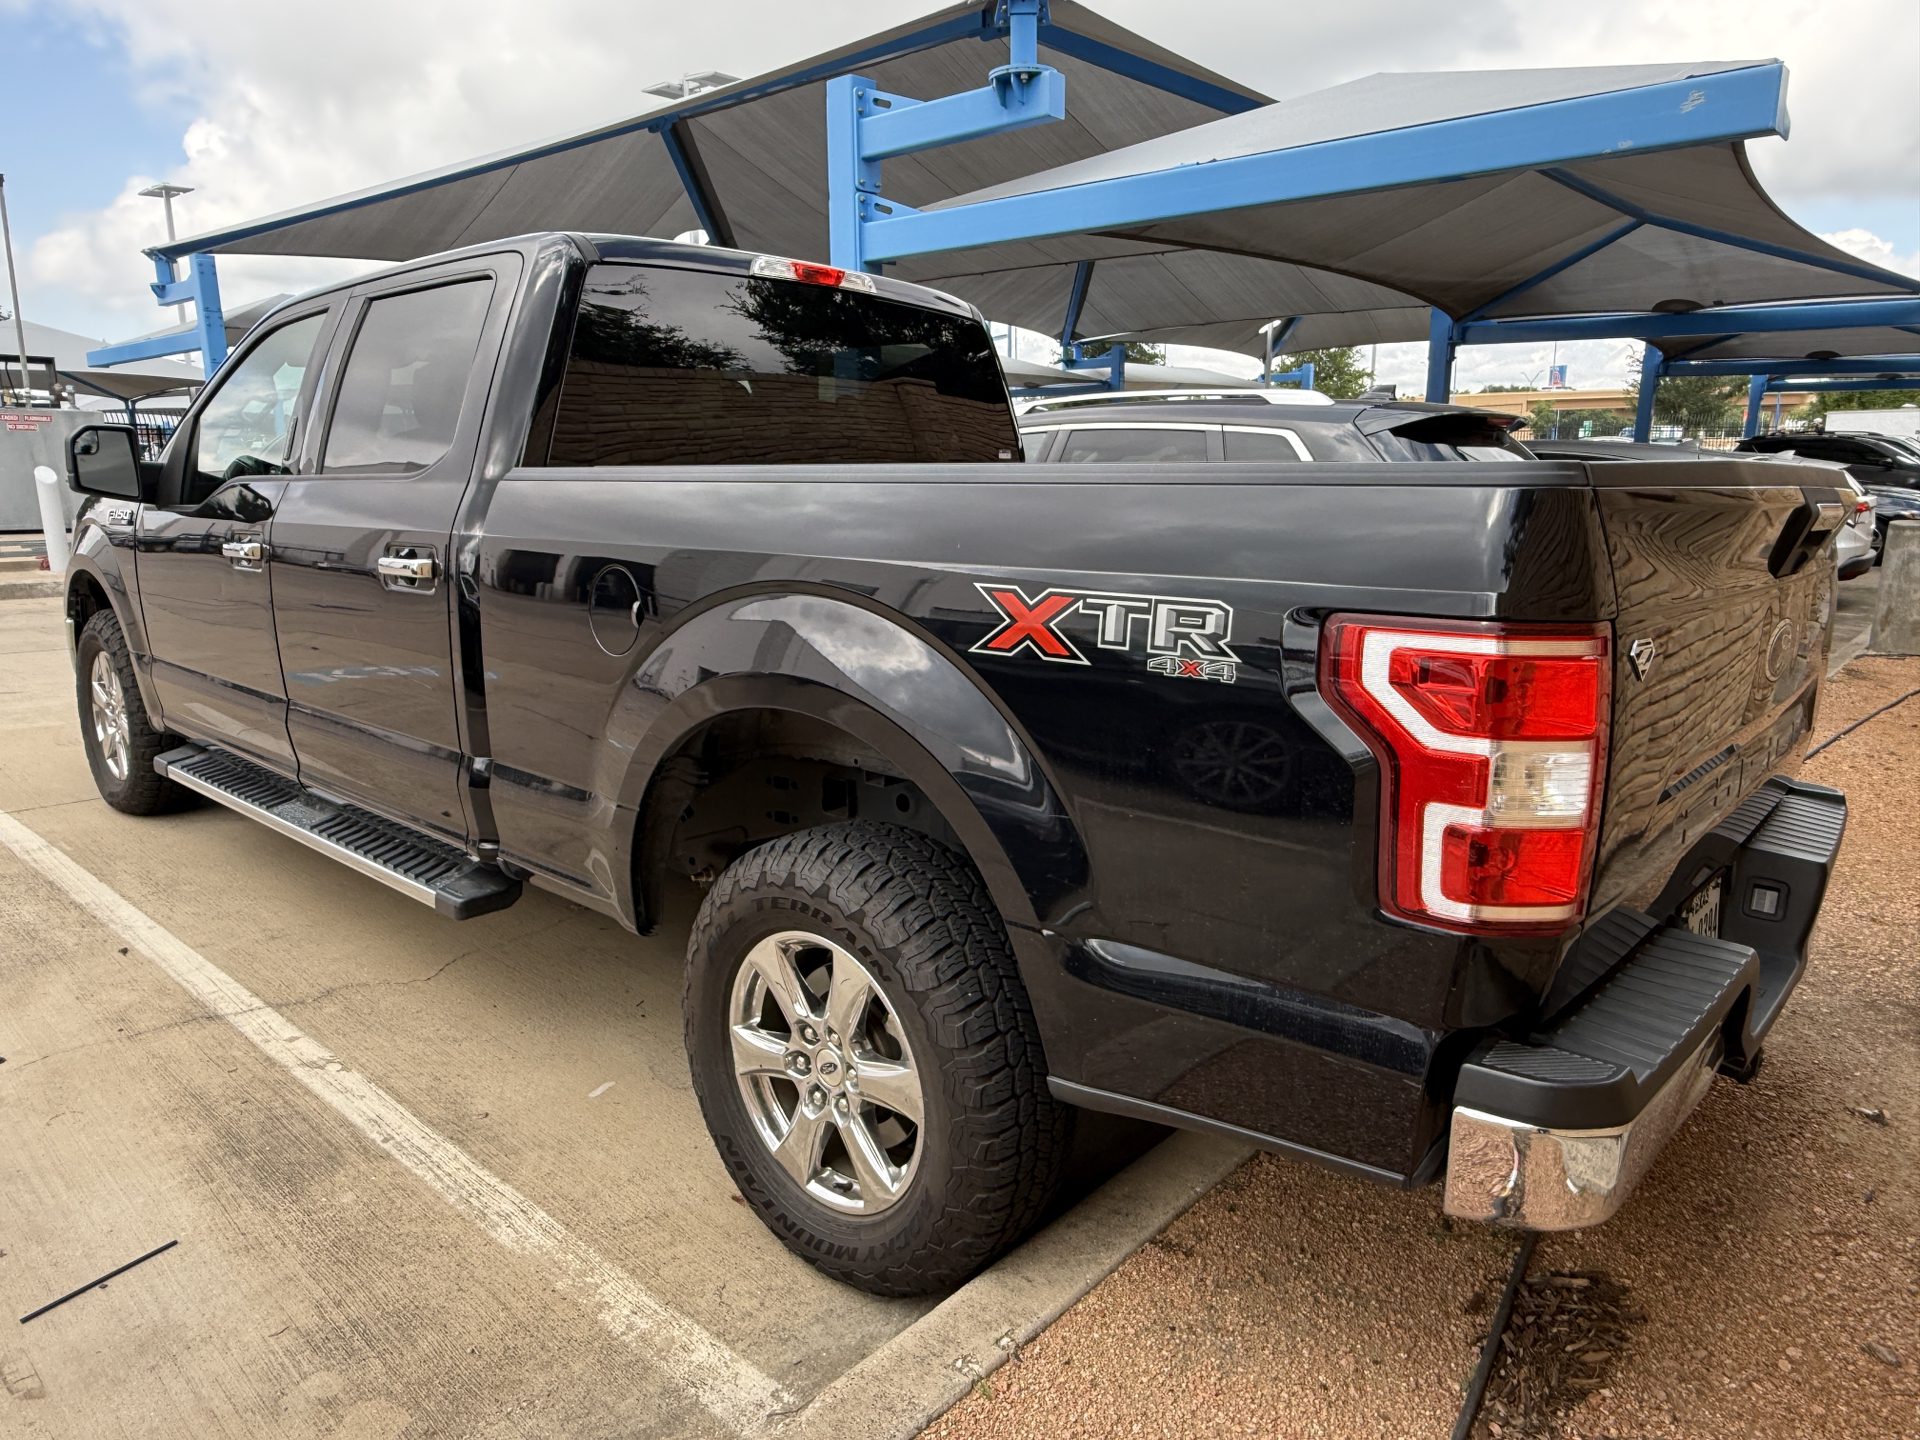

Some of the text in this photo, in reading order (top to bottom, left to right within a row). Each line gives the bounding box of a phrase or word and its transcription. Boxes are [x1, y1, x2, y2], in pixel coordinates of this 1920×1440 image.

[968, 582, 1242, 665] XTR
[751, 896, 893, 982] TERRAIN
[719, 1134, 859, 1262] MOUNTAIN
